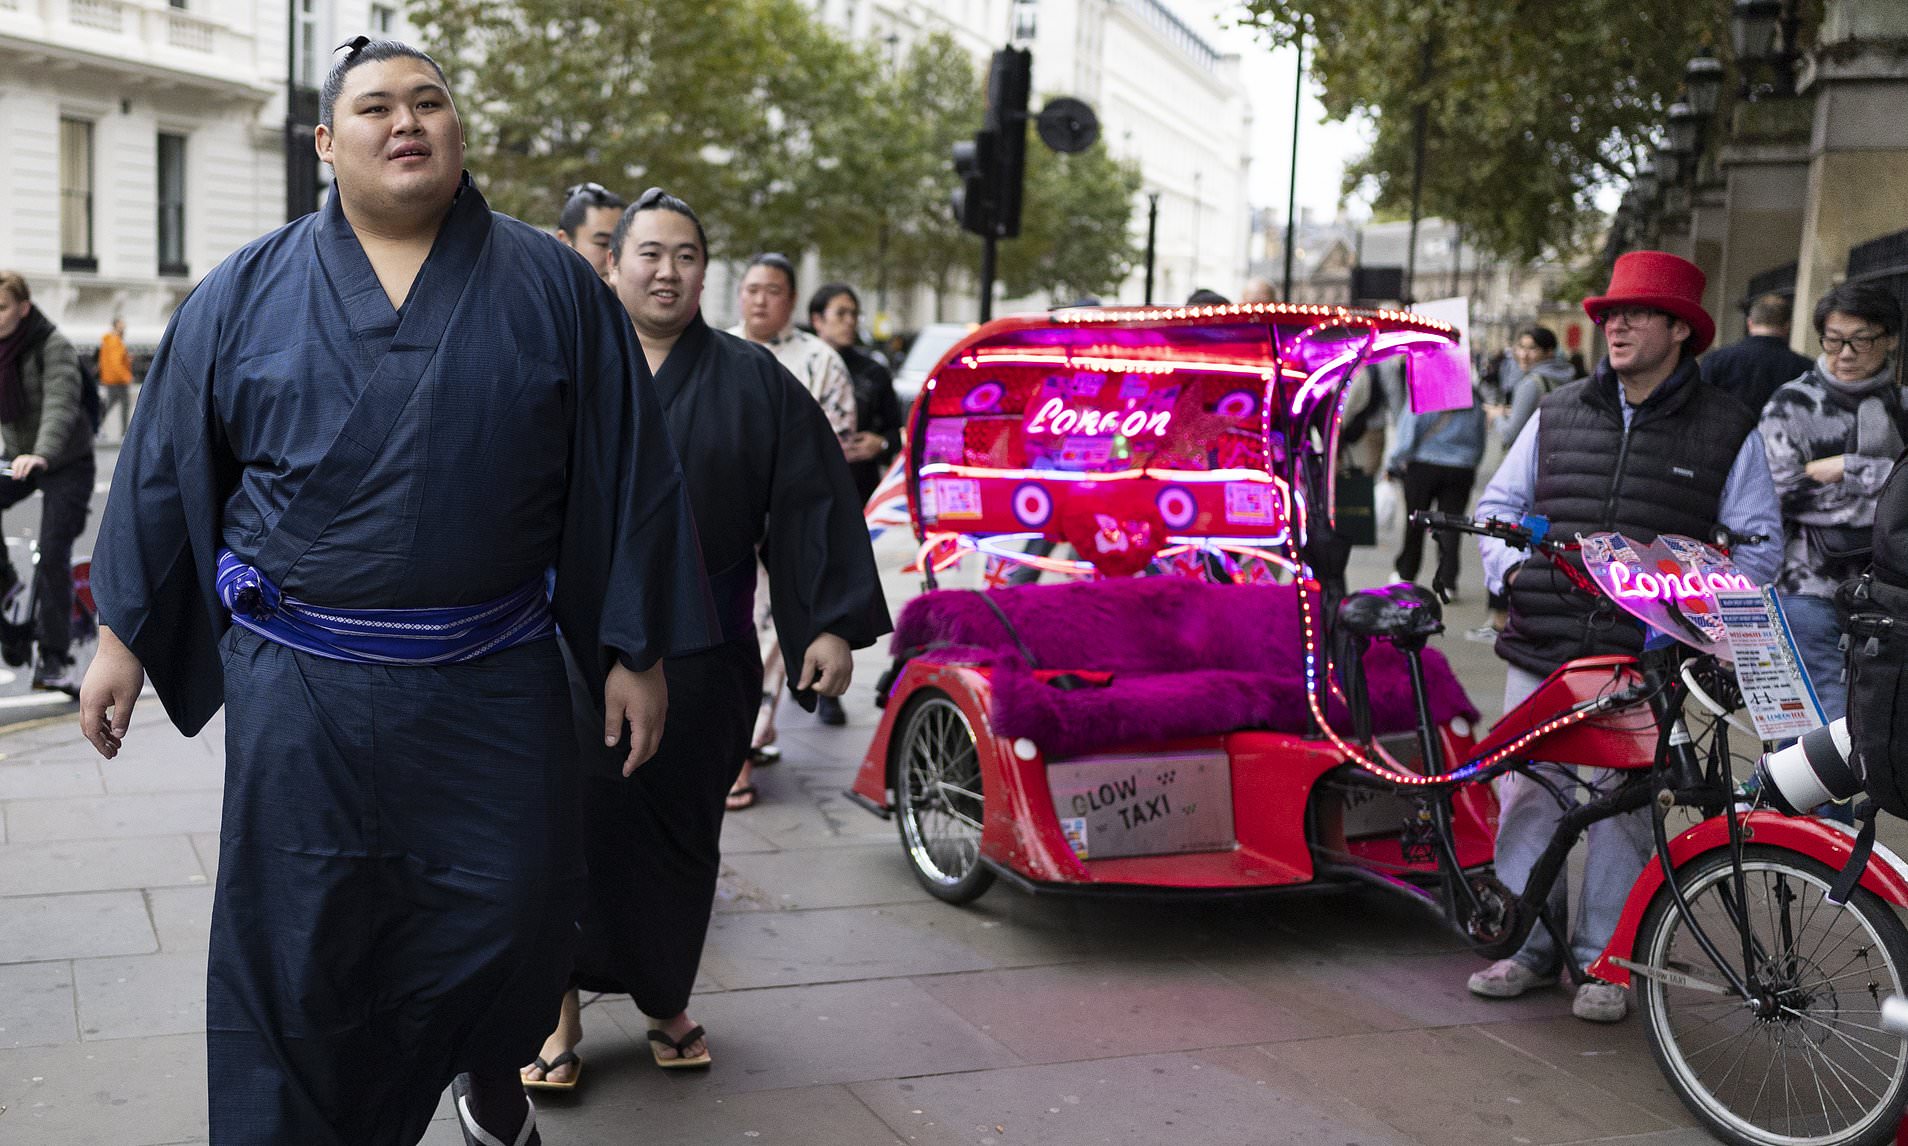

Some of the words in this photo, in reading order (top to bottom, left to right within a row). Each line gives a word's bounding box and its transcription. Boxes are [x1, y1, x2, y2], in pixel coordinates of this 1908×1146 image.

[1609, 560, 1757, 599] London
[1071, 775, 1137, 817] GLOW
[1118, 793, 1171, 830] TAXI
